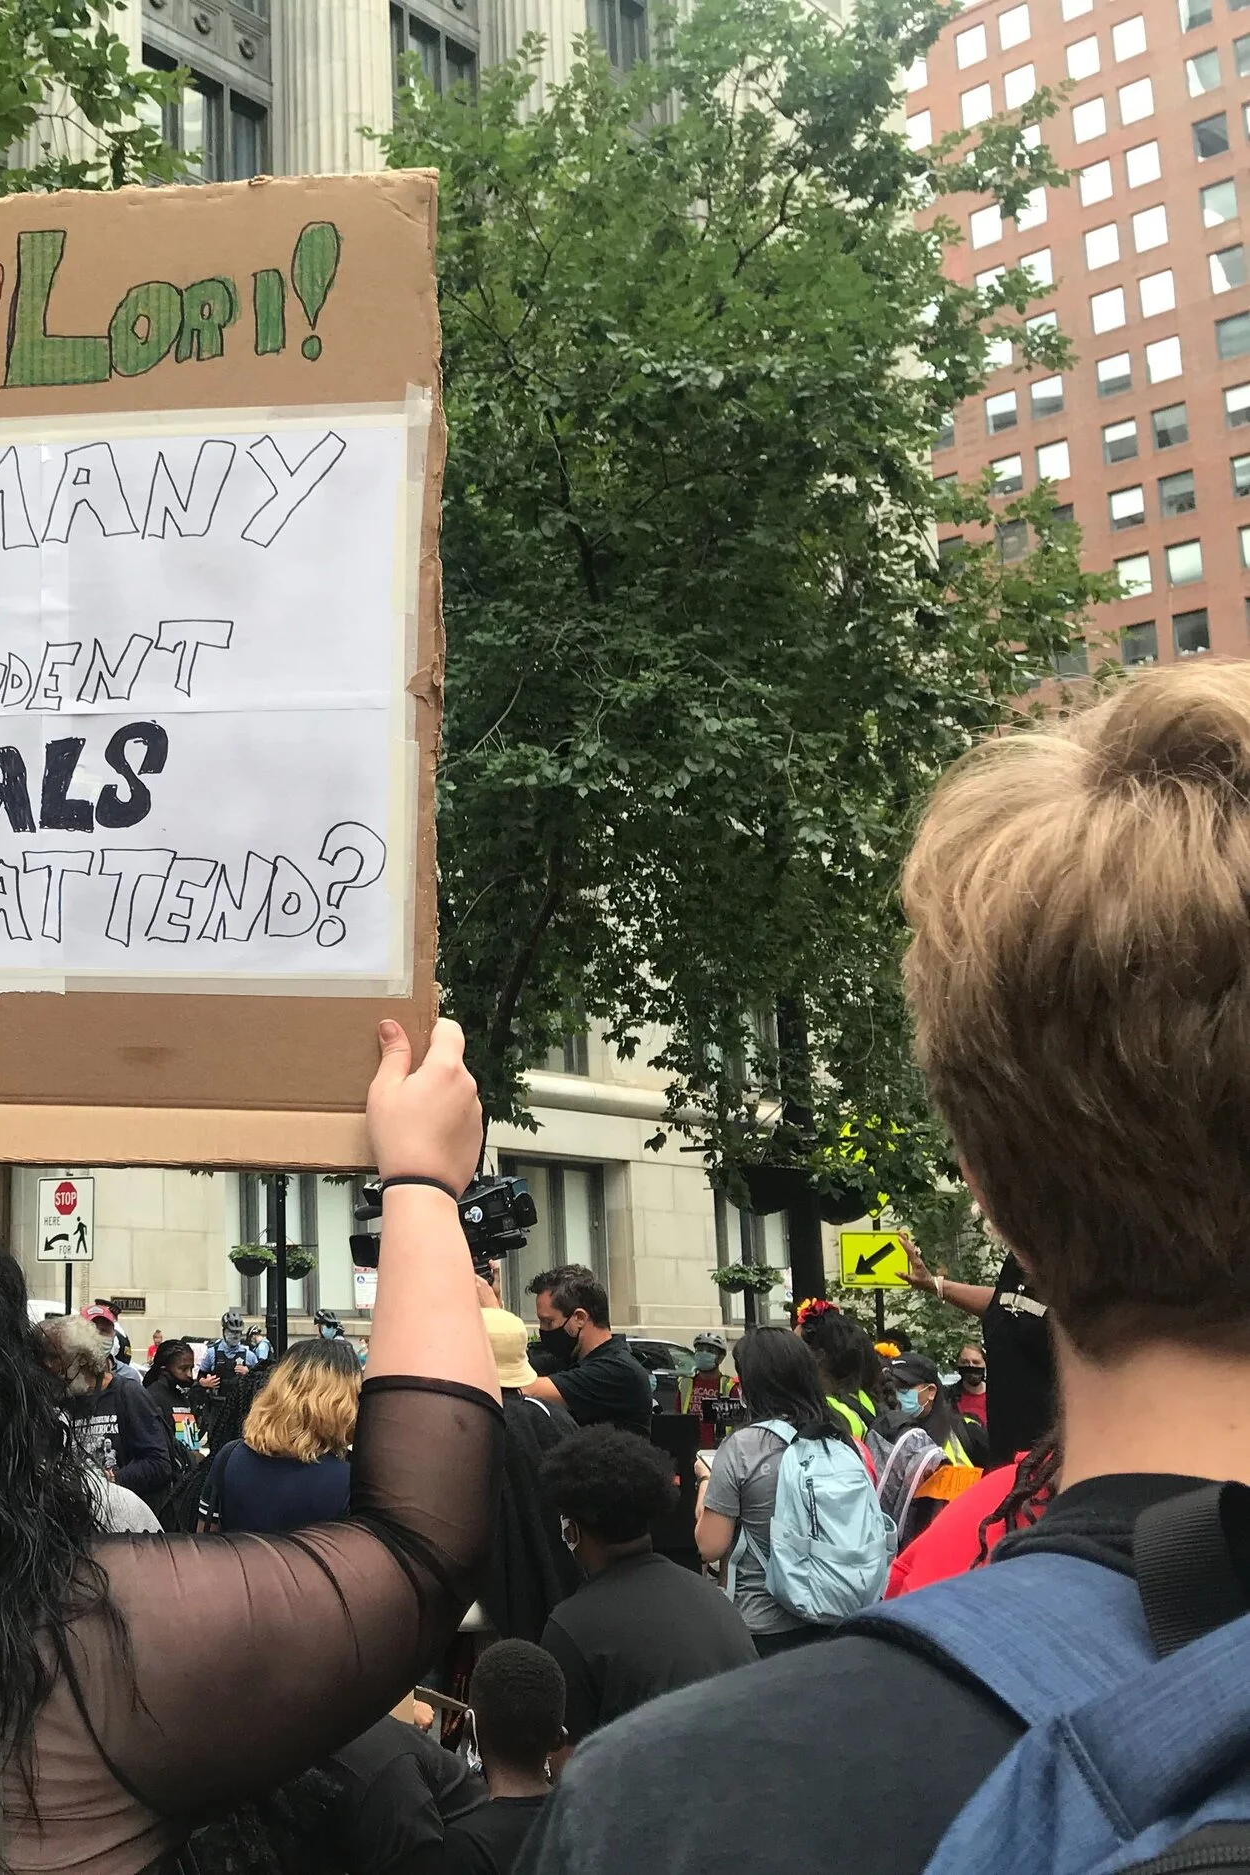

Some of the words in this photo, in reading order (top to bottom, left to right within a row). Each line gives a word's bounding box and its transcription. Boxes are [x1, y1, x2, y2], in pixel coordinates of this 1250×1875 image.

[0, 221, 342, 390] LORI!
[55, 1191, 77, 1206] STOP
[43, 1216, 61, 1226] HERE
[58, 1245, 72, 1255] FOR
[129, 1300, 144, 1310] HALL
